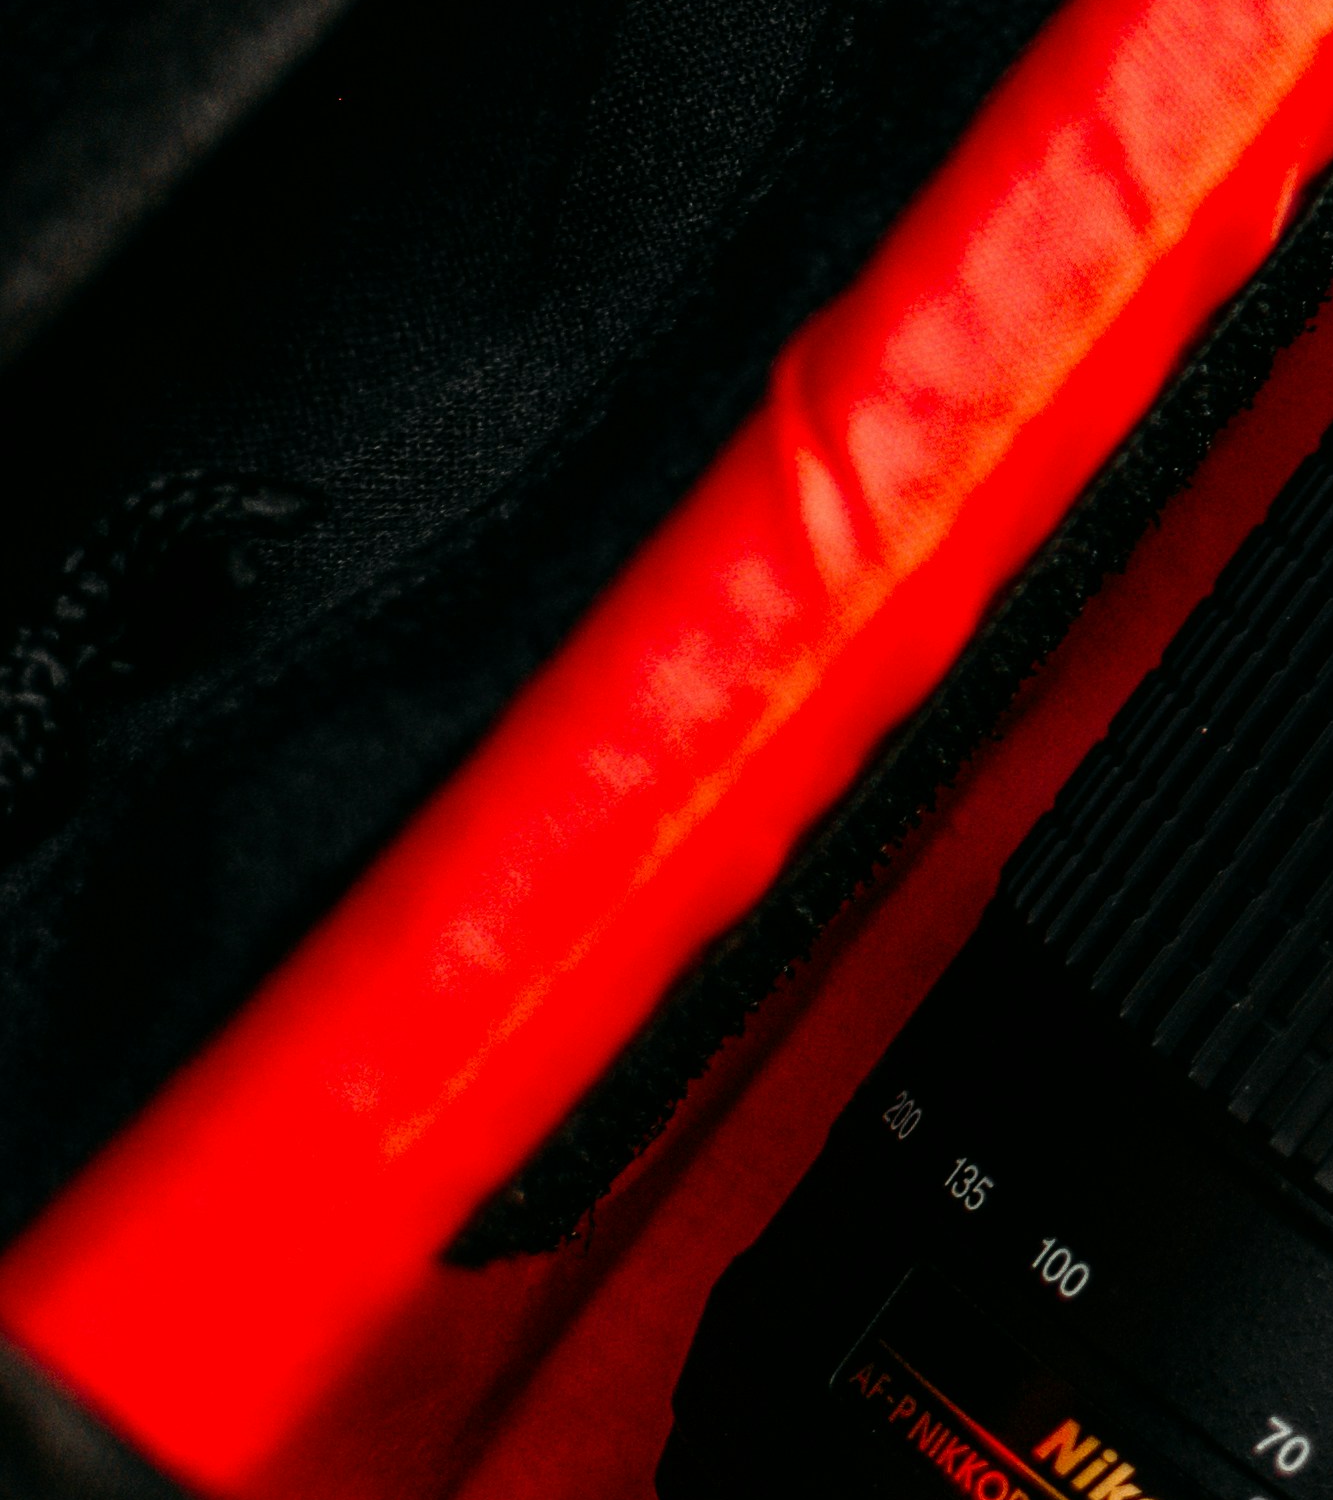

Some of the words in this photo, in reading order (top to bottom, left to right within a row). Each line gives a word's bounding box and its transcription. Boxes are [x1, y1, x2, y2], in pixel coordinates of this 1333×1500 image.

[881, 1088, 925, 1142] 200
[943, 1156, 996, 1213] 135
[1029, 1235, 1092, 1300] 100
[1252, 1415, 1313, 1475] 70
